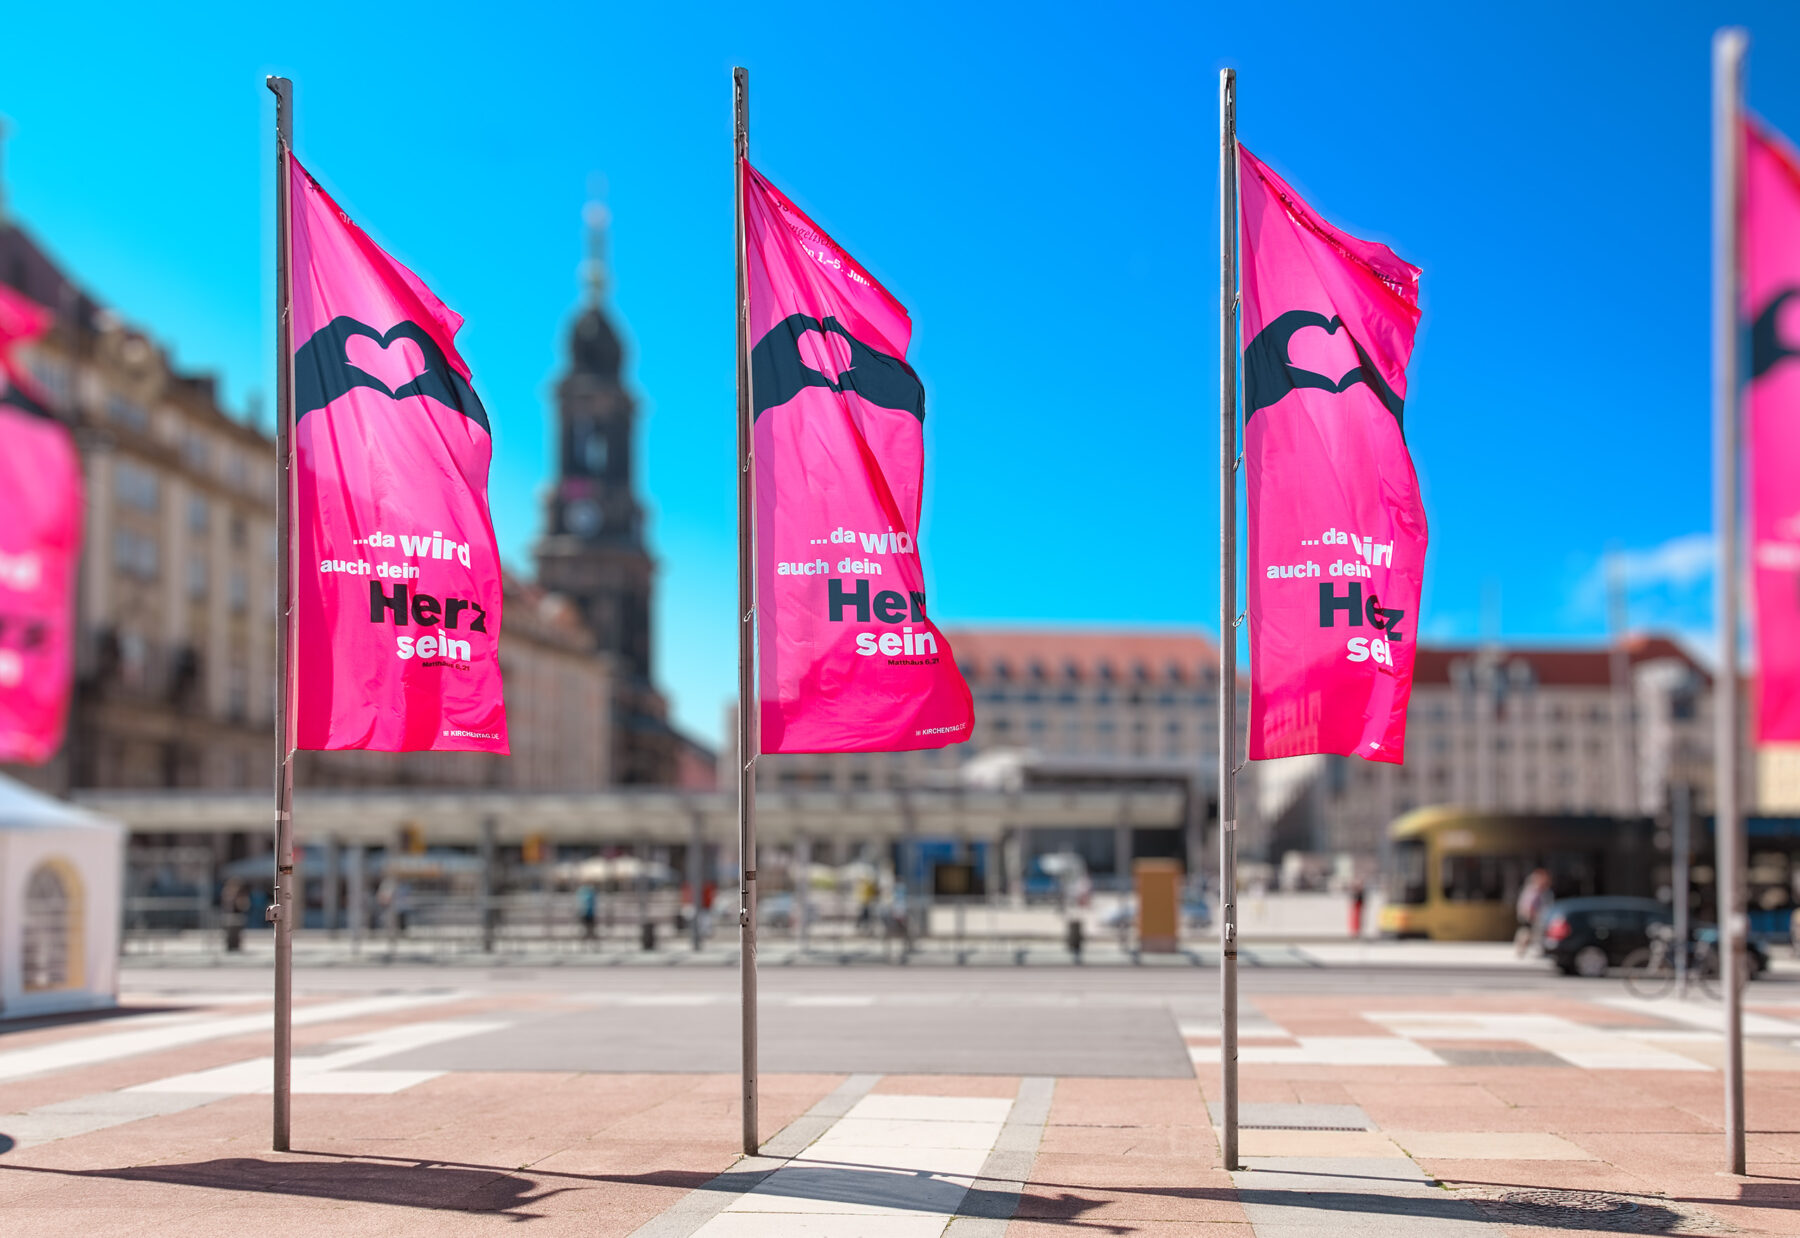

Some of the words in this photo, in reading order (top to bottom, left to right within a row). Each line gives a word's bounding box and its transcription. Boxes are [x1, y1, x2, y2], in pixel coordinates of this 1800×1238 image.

[400, 531, 471, 569] wird
[859, 526, 914, 555] wid
[320, 559, 371, 575] auch
[376, 562, 420, 579] dein
[777, 559, 830, 575] auch
[837, 558, 882, 575] dein
[1266, 561, 1320, 579] auch
[1328, 560, 1372, 578] dein
[369, 580, 488, 634] Herz
[828, 578, 926, 624] Her
[1319, 582, 1405, 642] Hez
[396, 629, 471, 662] sein
[855, 626, 938, 657] sein
[1346, 635, 1394, 667] sei
